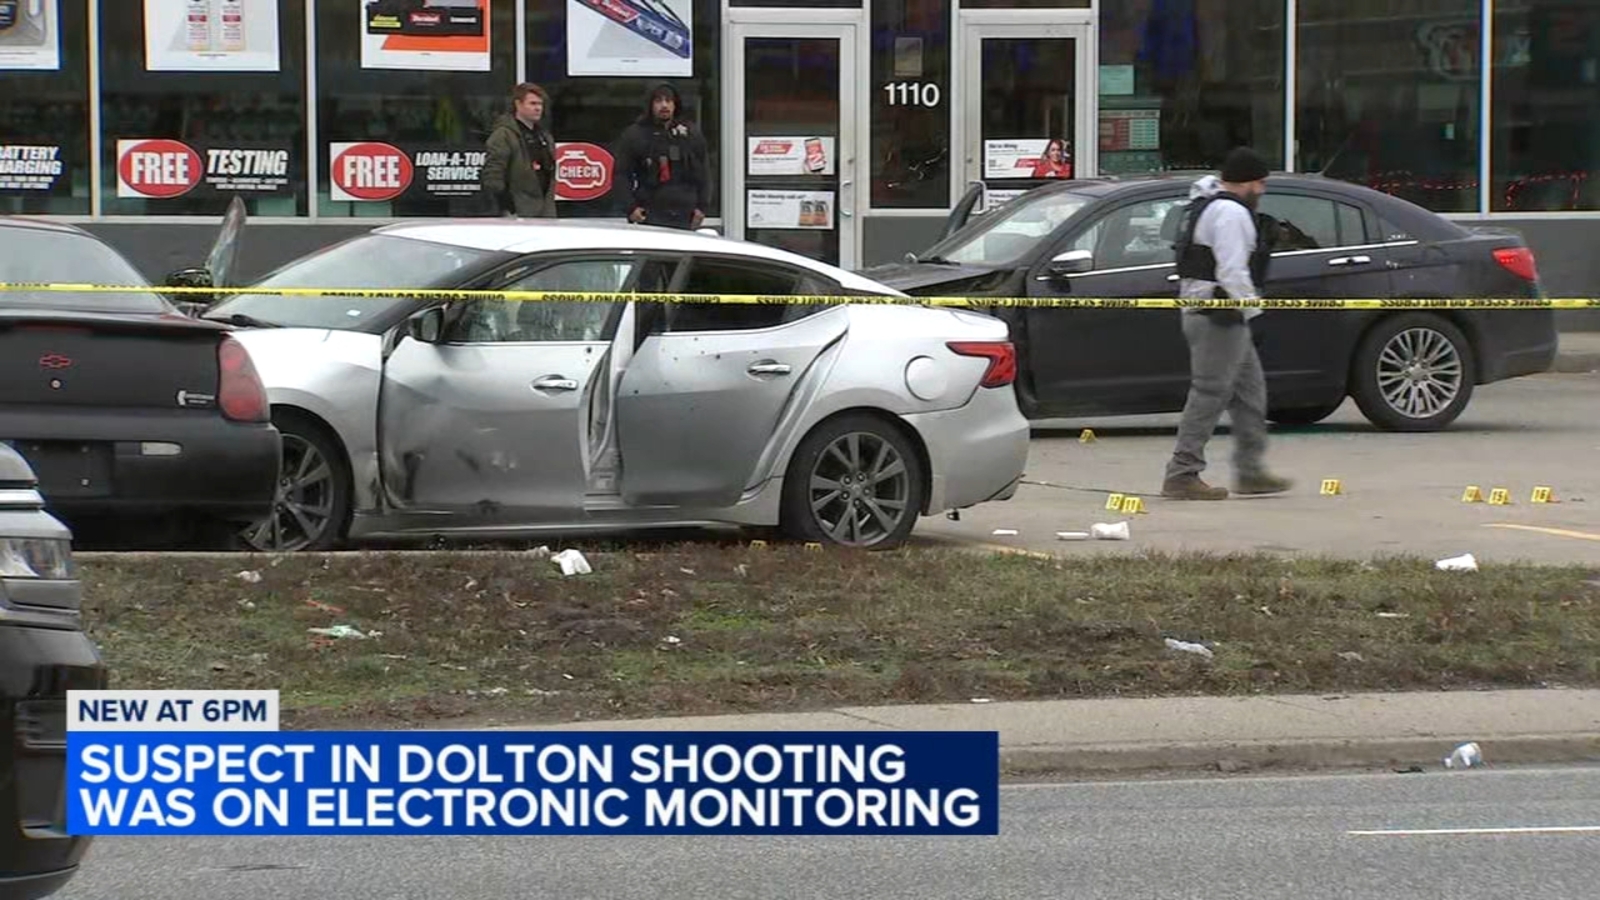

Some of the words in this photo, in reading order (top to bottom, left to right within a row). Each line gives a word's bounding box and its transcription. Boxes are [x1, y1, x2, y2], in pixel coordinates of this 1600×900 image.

[884, 83, 939, 107] 1110
[131, 152, 190, 184] FREE
[206, 149, 288, 175] TESTING
[343, 155, 400, 188] FREE
[426, 166, 482, 180] SERVICE
[559, 165, 600, 178] CHECK
